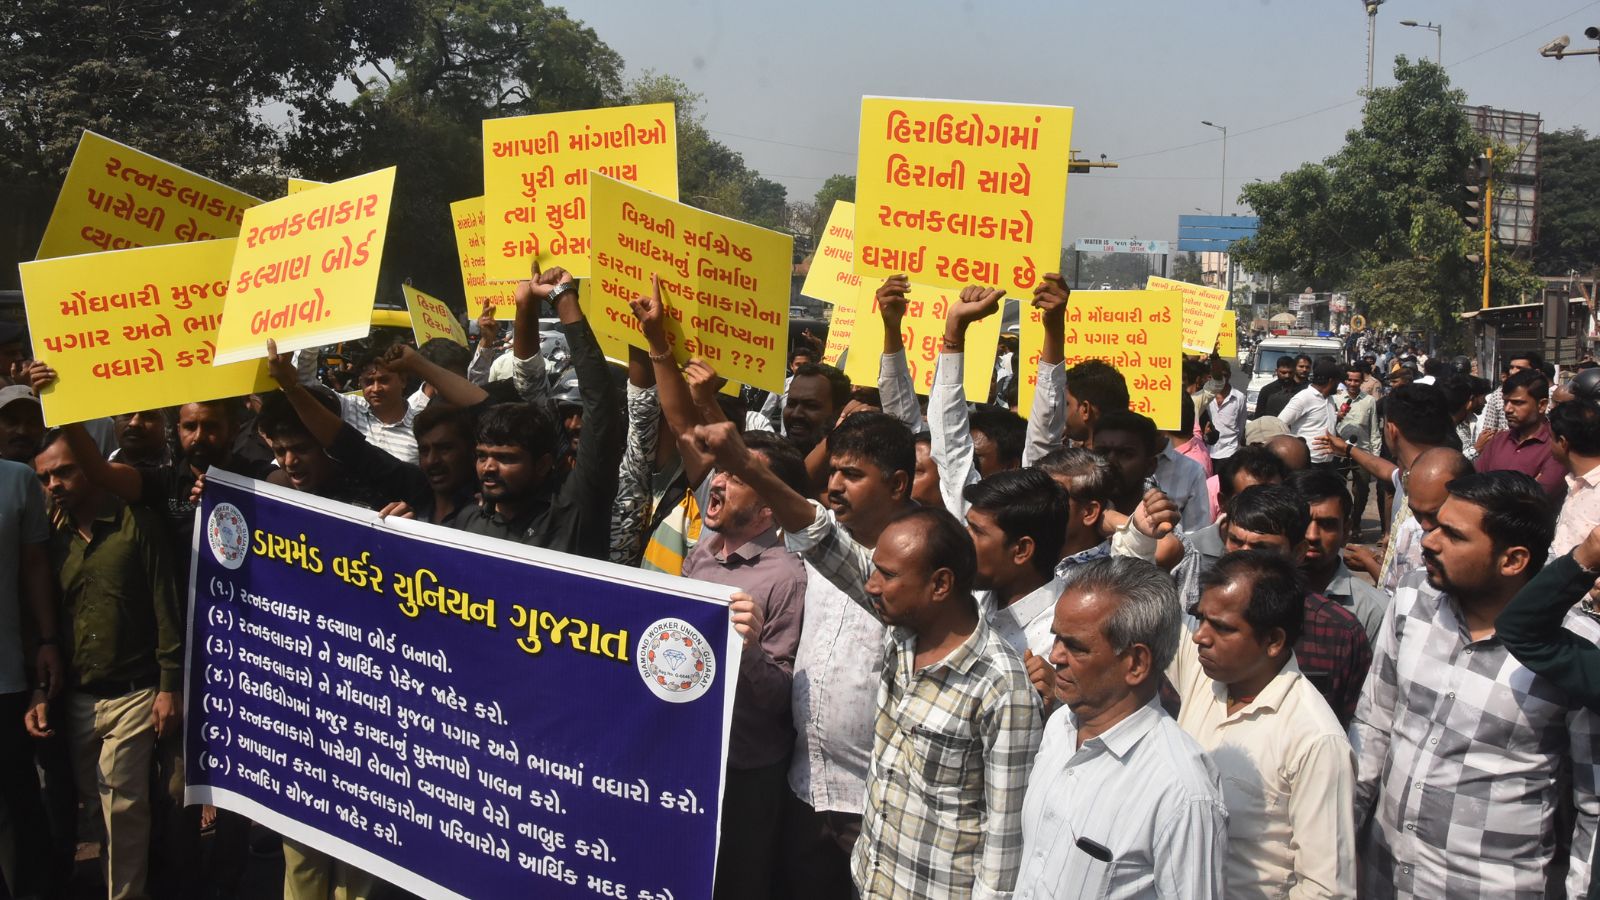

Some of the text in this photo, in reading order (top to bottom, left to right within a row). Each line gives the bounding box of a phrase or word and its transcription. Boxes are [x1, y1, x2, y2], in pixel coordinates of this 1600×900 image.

[492, 119, 666, 158] આપણી માંગણીઓ
[105, 157, 256, 226] રત્નકલાકાર
[522, 165, 554, 198] પુરી
[565, 168, 588, 186] ના
[886, 154, 1031, 196] હિરાની સાથે
[88, 188, 165, 232] પાસેથી
[246, 194, 378, 248] રત્નકલાકાર
[504, 198, 536, 224] ત્યાં
[546, 197, 586, 229] સુધી
[878, 205, 1033, 244] રત્નકલાકારો
[502, 232, 539, 258] કામે
[622, 202, 752, 263] વિશ્વની સર્વશ્રેષ્ઠ
[237, 229, 376, 293] કલ્યાણ બોર્ડ
[598, 252, 642, 281] કારતા
[698, 258, 757, 292] નિર્માણ
[862, 246, 926, 273] ઘસાઈ
[60, 284, 160, 316] મોંઘવારી
[251, 288, 330, 334] બનાવો.
[1088, 306, 1142, 322] મોંઘવારી
[1149, 306, 1172, 322] નડે
[44, 330, 110, 353] પગાર
[123, 314, 171, 340] અને
[691, 315, 774, 351] ભવિષ્યના
[1084, 333, 1119, 344] પગાર
[1126, 329, 1148, 345] વધે
[92, 348, 164, 379] વધારો
[684, 336, 720, 360] કોણ
[731, 350, 766, 372] ???
[1149, 357, 1172, 368] પણ
[1134, 374, 1172, 390] એટલે
[252, 529, 628, 661] ડાયમંડ વર્કર યુનિયન ગુજરાત
[210, 576, 452, 674] (૧.) રત્નકલાકાર કલ્યાણ બોર્ડ બનાવો.
[208, 606, 508, 725] (૨.) રત્નકલાકારો ને આર્થિક પેકેજ જાહેર કરો.
[640, 622, 712, 688] DIAMOND WORKER UNION GUJARAT
[204, 664, 234, 689] (૪.)
[316, 707, 348, 734] મજુર
[354, 720, 408, 760] કાયદાનું
[413, 744, 470, 780] ચુસ્તપણે
[478, 768, 522, 800] પાલન
[530, 789, 566, 814] કરો.
[206, 635, 704, 814] (૩.) રત્નકલાકારો ને મોંઘવારી મુજબ પગાર અને ભાવમાં વધારો કરો.
[239, 706, 314, 748] રત્નકલાકારો
[320, 738, 362, 768] પાસેથી
[368, 753, 410, 788] લેવાતો
[418, 778, 474, 816] વ્યવસાય
[482, 800, 510, 829] વેરો
[518, 822, 566, 852] નાબુદ
[575, 838, 616, 862] કરો.
[237, 763, 280, 794] રત્નદિપ
[286, 782, 330, 814] યોજના
[336, 804, 368, 831] જાહેર
[374, 822, 402, 846] કરો.
[238, 734, 286, 767] આપઘાત
[293, 757, 326, 783] કરતા
[332, 774, 432, 830] રત્નકલાકારોના
[439, 819, 510, 862] પરિવારોને
[518, 852, 578, 885] આર્થિક
[588, 874, 627, 900] મદદ
